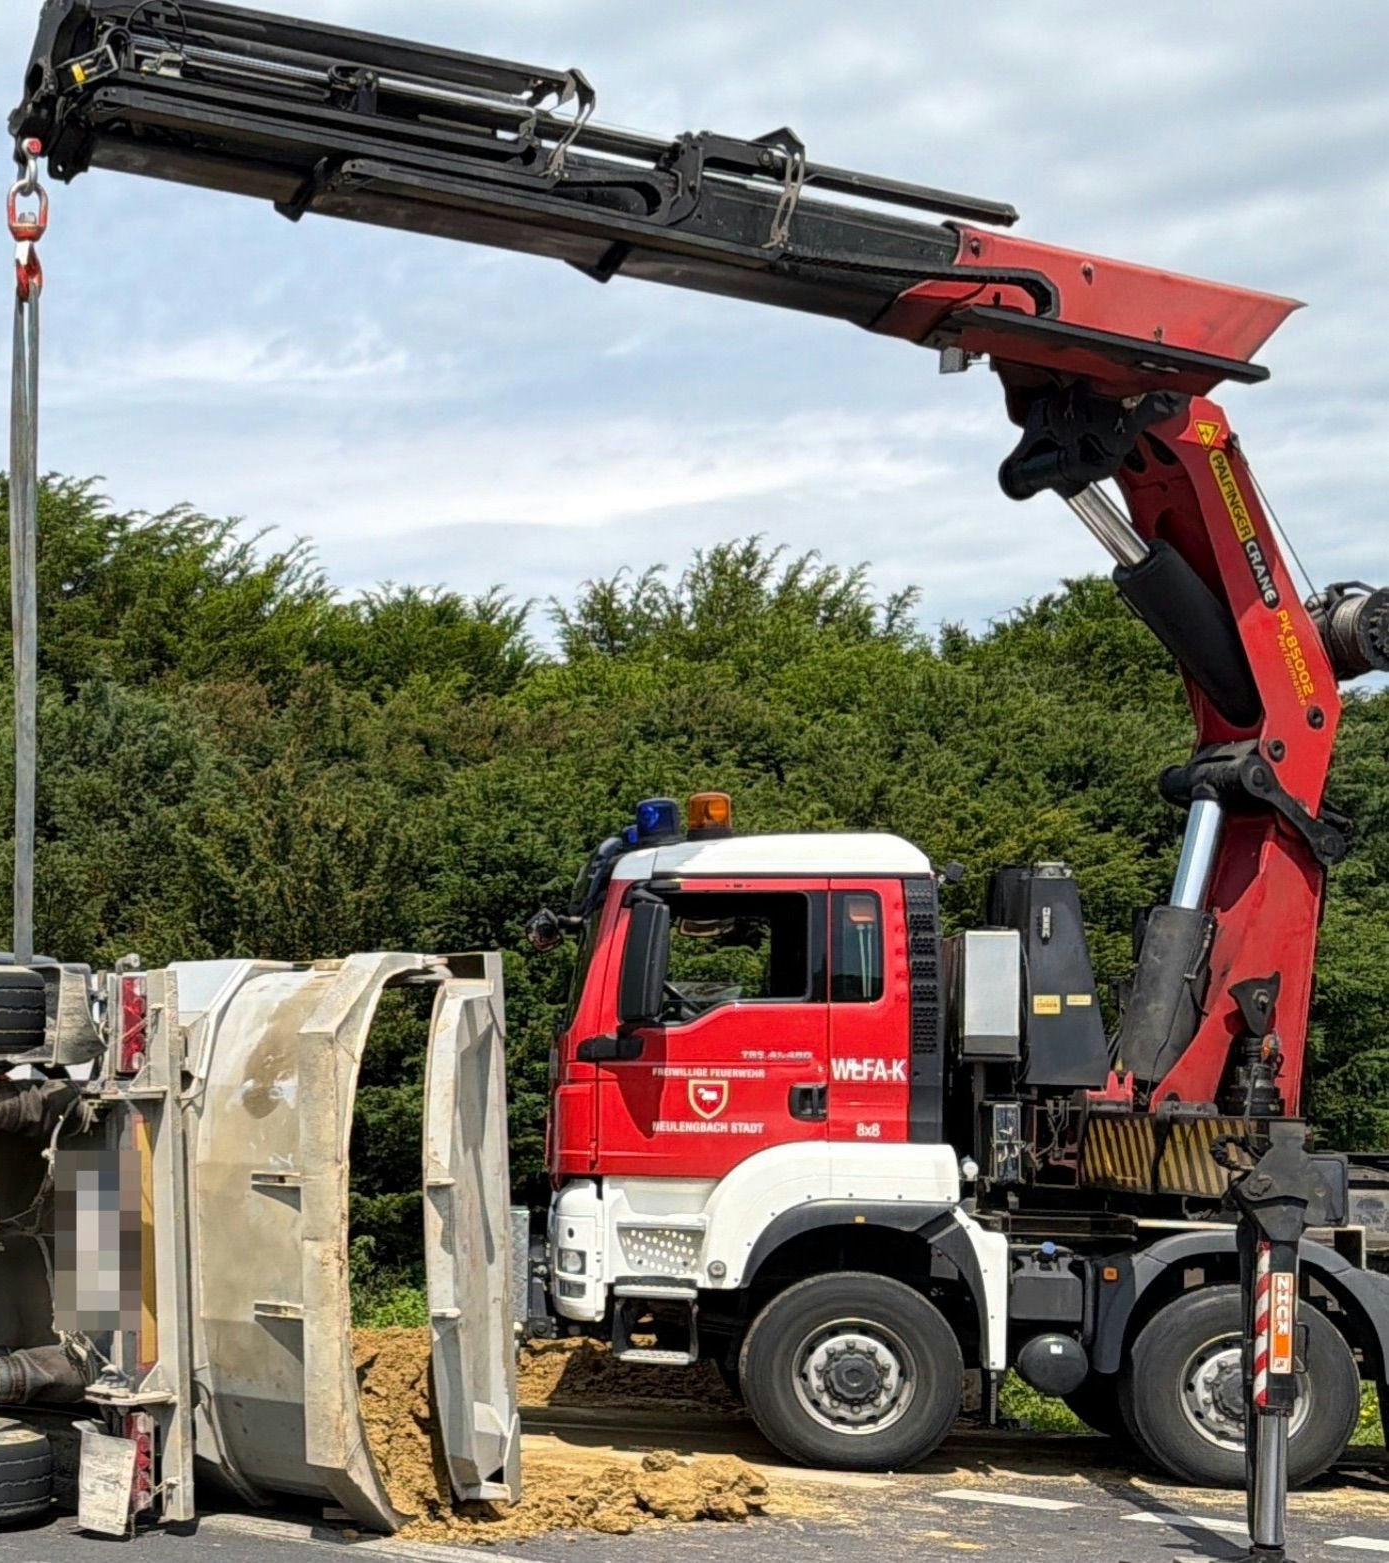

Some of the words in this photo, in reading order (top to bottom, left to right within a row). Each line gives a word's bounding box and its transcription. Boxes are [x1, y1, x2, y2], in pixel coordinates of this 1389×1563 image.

[1212, 453, 1252, 538] PALFINGER
[1245, 540, 1278, 604] CRANE
[1276, 609, 1293, 637] PK
[1286, 635, 1314, 696] 85002
[1277, 634, 1307, 707] Performance
[652, 1066, 708, 1077] FREIWILLIGE
[710, 1067, 766, 1078] FEUERWEHR
[652, 1121, 729, 1133] NEULENGBACH
[731, 1122, 765, 1134] STADT
[855, 1122, 881, 1138] 8x8
[1276, 1275, 1290, 1336] KUHN
